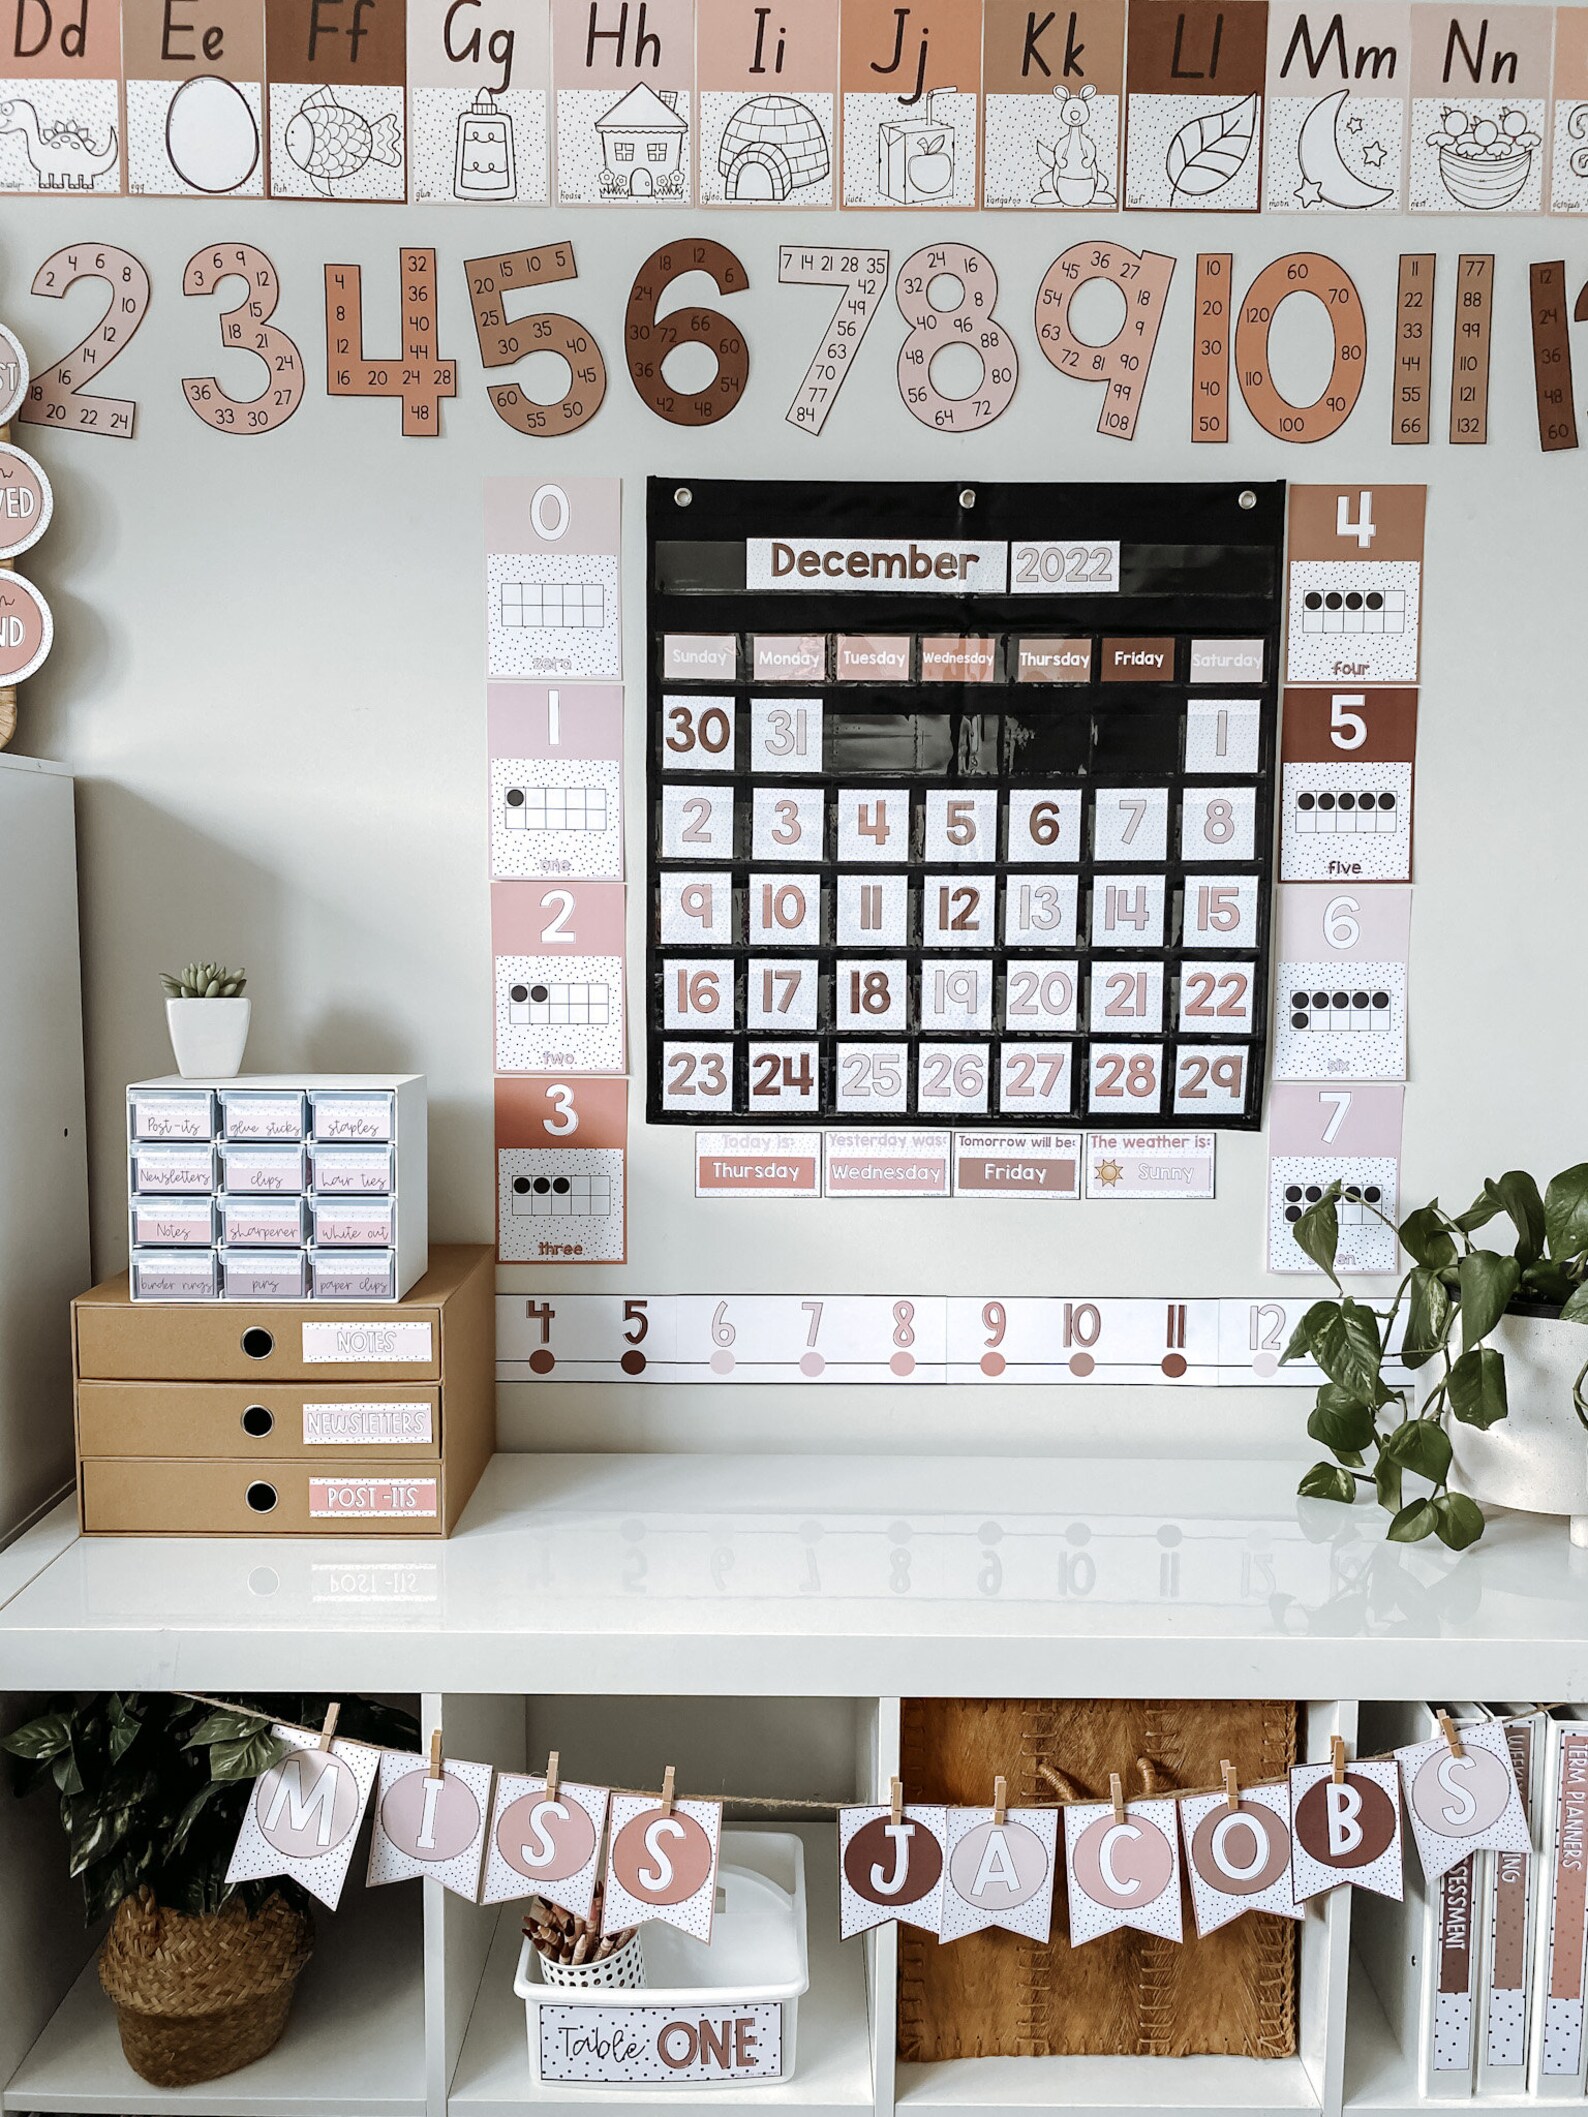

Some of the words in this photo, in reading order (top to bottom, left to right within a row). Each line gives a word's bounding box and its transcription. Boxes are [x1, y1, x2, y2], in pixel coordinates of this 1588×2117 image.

[14, 0, 88, 58] Dd
[160, 0, 225, 61] Ee
[307, 0, 376, 62] Ff
[585, 2, 662, 69] Hh
[443, 0, 515, 95] Gg
[748, 7, 787, 74] Ii
[1021, 11, 1086, 78] Kk
[1170, 13, 1224, 80] Ll
[1279, 13, 1397, 80] Mm
[870, 8, 931, 106] Jj
[1441, 18, 1518, 84] Nn
[408, 256, 427, 272] 32
[500, 260, 513, 277] 15
[801, 254, 814, 270] 14
[1090, 251, 1110, 268] 36
[1466, 261, 1485, 276] 77
[256, 271, 269, 287] 12
[121, 298, 136, 313] 10
[690, 316, 711, 331] 66
[1246, 308, 1270, 323] 120
[953, 318, 973, 332] 96
[1402, 357, 1420, 371] 44
[190, 386, 211, 401] 36
[497, 390, 518, 407] 60
[110, 412, 128, 430] 24
[411, 405, 429, 420] 48
[796, 406, 815, 422] 84
[934, 409, 955, 424] 64
[1105, 412, 1129, 430] 108
[1279, 417, 1305, 432] 100
[1457, 418, 1479, 433] 132
[530, 483, 571, 541] 0
[1336, 491, 1376, 549] 4
[770, 542, 980, 580] December
[1016, 547, 1114, 583] 2022
[672, 648, 727, 666] Sunday
[758, 650, 820, 667] Monday
[843, 650, 906, 667] Tuesday
[922, 651, 995, 667] Wednesday
[1020, 650, 1091, 668] Thursday
[1113, 650, 1164, 668] Friday
[1192, 652, 1264, 669] Saturday
[1332, 660, 1370, 676] four
[665, 706, 731, 755] 30
[764, 709, 807, 756] 31
[1216, 709, 1228, 757] 1
[1330, 694, 1368, 751] 5
[681, 797, 712, 842] 2
[771, 799, 802, 845] 3
[858, 799, 890, 846] 4
[945, 800, 976, 846] 5
[1029, 800, 1061, 846] 6
[1118, 799, 1148, 845] 7
[1203, 798, 1235, 845] 8
[1328, 860, 1361, 874] five
[680, 882, 713, 929] 9
[762, 883, 806, 930] 10
[860, 884, 882, 930] 11
[938, 885, 980, 931] 12
[1019, 885, 1062, 930] 13
[1105, 885, 1150, 931] 14
[1196, 886, 1240, 931] 15
[539, 889, 576, 944] 2
[1322, 895, 1361, 950] 6
[678, 968, 721, 1014] 16
[762, 968, 802, 1014] 17
[850, 969, 892, 1014] 18
[934, 969, 978, 1015] 19
[1009, 970, 1074, 1016] 20
[1105, 971, 1148, 1017] 21
[1185, 971, 1248, 1017] 22
[543, 1050, 575, 1065] two
[1327, 1058, 1350, 1072] six
[667, 1052, 728, 1096] 23
[752, 1052, 814, 1096] 24
[841, 1053, 902, 1097] 25
[922, 1053, 985, 1097] 26
[1004, 1053, 1065, 1098] 27
[1094, 1054, 1157, 1098] 28
[1178, 1054, 1244, 1099] 29
[543, 1083, 580, 1136] 3
[1318, 1091, 1352, 1144] 7
[147, 1116, 200, 1136] Post-its
[230, 1120, 259, 1136] glue
[266, 1121, 301, 1136] sticks
[328, 1119, 380, 1136] staples
[721, 1133, 778, 1152] Today
[829, 1132, 907, 1149] Yesterday
[959, 1135, 1028, 1148] Tomorrow
[1031, 1135, 1051, 1148] will
[1054, 1135, 1077, 1148] be:
[1091, 1135, 1117, 1148] The
[1120, 1135, 1188, 1149] weather
[1192, 1136, 1212, 1149] is:
[140, 1169, 211, 1185] Newsletters
[250, 1171, 283, 1188] clips
[361, 1173, 387, 1189] ties
[712, 1161, 801, 1183] Thursday
[831, 1163, 941, 1185] Wednesday
[984, 1163, 1047, 1185] Friday
[1137, 1163, 1195, 1184] Sunny
[156, 1223, 191, 1239] Notes
[230, 1223, 298, 1240] sharpener
[322, 1225, 361, 1240] white
[367, 1226, 389, 1240] out
[538, 1241, 583, 1256] three
[140, 1279, 176, 1291] binder
[181, 1280, 213, 1293] rings
[252, 1280, 279, 1293] pins
[320, 1281, 353, 1293] paper
[359, 1278, 387, 1294] clips
[525, 1300, 555, 1344] 4
[623, 1300, 648, 1345] 5
[711, 1300, 736, 1347] 6
[801, 1302, 824, 1347] 7
[892, 1300, 915, 1348] 8
[981, 1301, 1006, 1347] 9
[1063, 1303, 1101, 1348] 10
[1166, 1304, 1188, 1349] 11
[1249, 1303, 1286, 1351] 12
[337, 1330, 397, 1353] NOTES
[307, 1412, 426, 1435] NEWSLETTERS
[327, 1486, 376, 1508] POST
[1562, 1789, 1588, 1871] PLANNERS
[556, 2025, 647, 2063] Table
[656, 2018, 759, 2070] ONE
